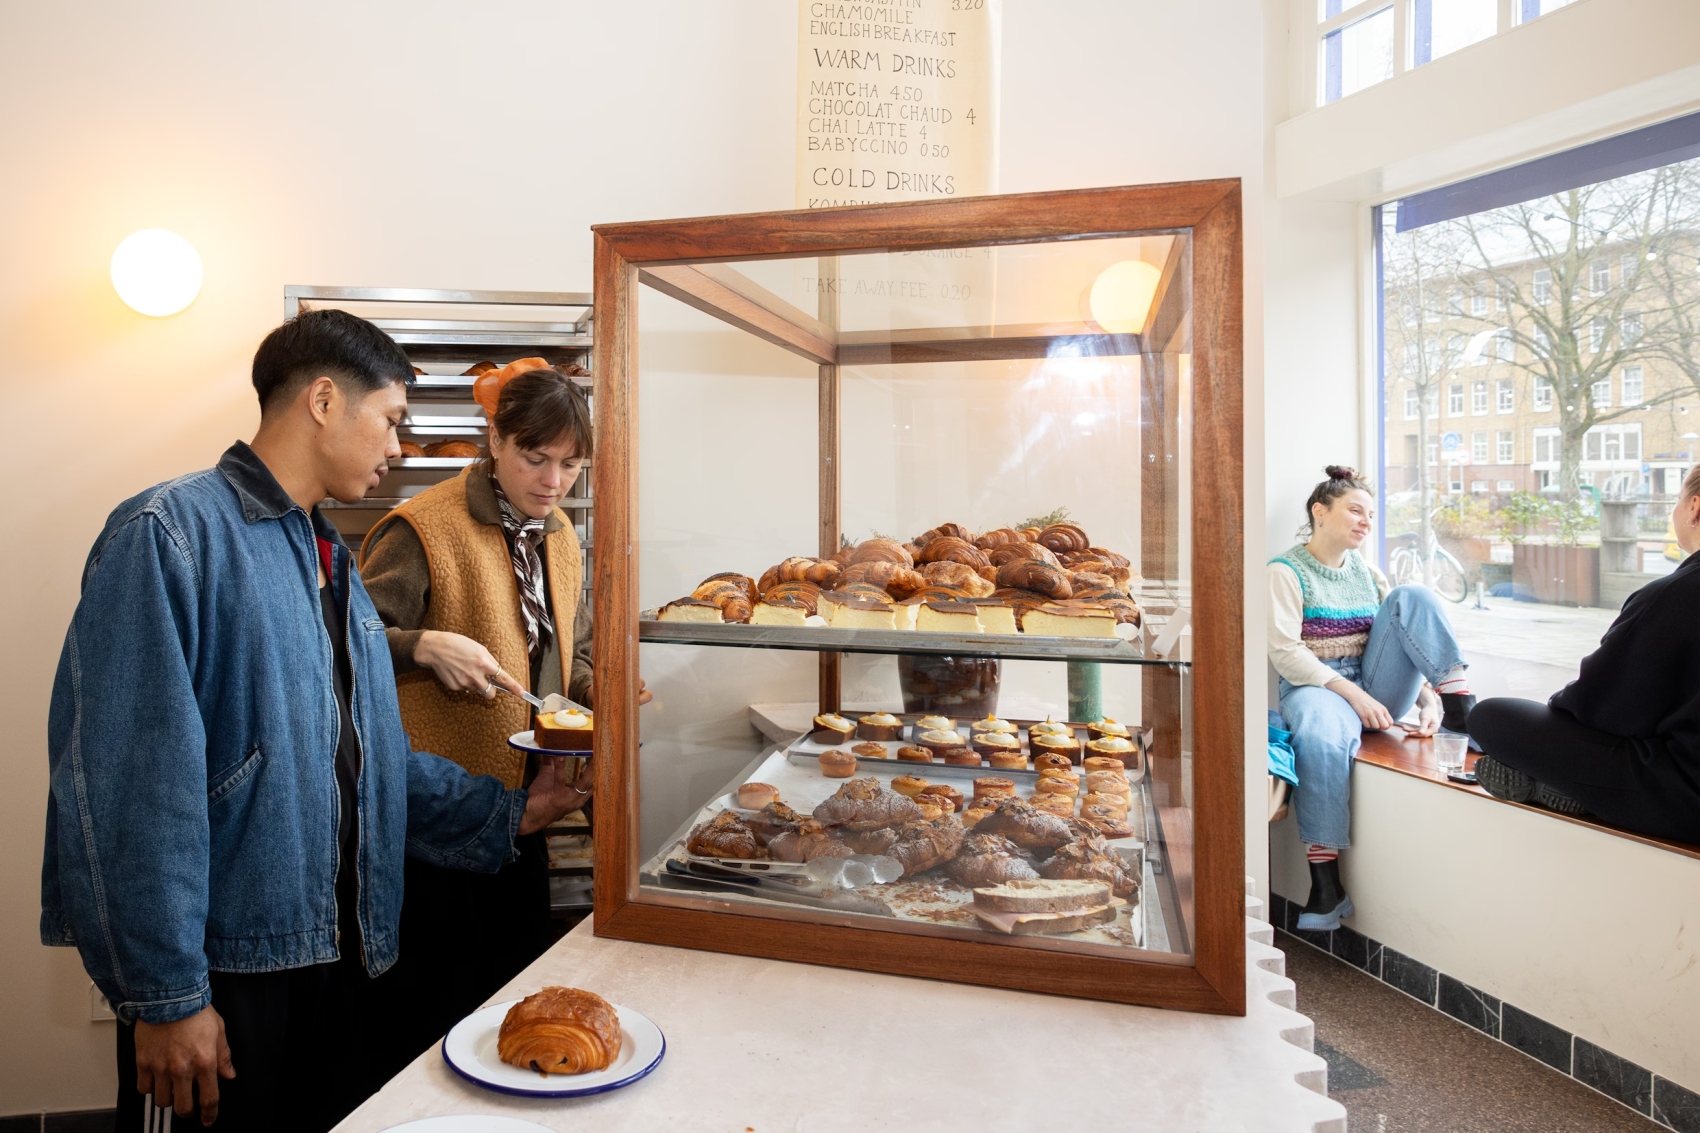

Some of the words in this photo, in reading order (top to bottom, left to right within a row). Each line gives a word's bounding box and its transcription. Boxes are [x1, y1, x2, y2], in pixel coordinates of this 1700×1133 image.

[810, 2, 914, 25] CHAMOMILE
[952, 0, 984, 11] 3.20
[813, 48, 881, 72] WARM
[892, 54, 956, 78] DRINKS
[810, 80, 879, 99] MATCHA
[890, 85, 923, 102] 4.50
[808, 98, 893, 119] CHOCOLAT
[900, 104, 953, 124] CHAUD
[966, 108, 977, 125] 4
[808, 118, 849, 134] CHAI
[857, 120, 908, 138] LATTE
[919, 125, 928, 140] 4
[808, 136, 908, 155] BABYCCINO
[920, 144, 950, 158] 0.50
[812, 167, 876, 188] COLD
[886, 170, 955, 195] DRINKS
[802, 277, 847, 294] TAKE
[854, 279, 895, 296] AWAY
[900, 281, 928, 299] FEE
